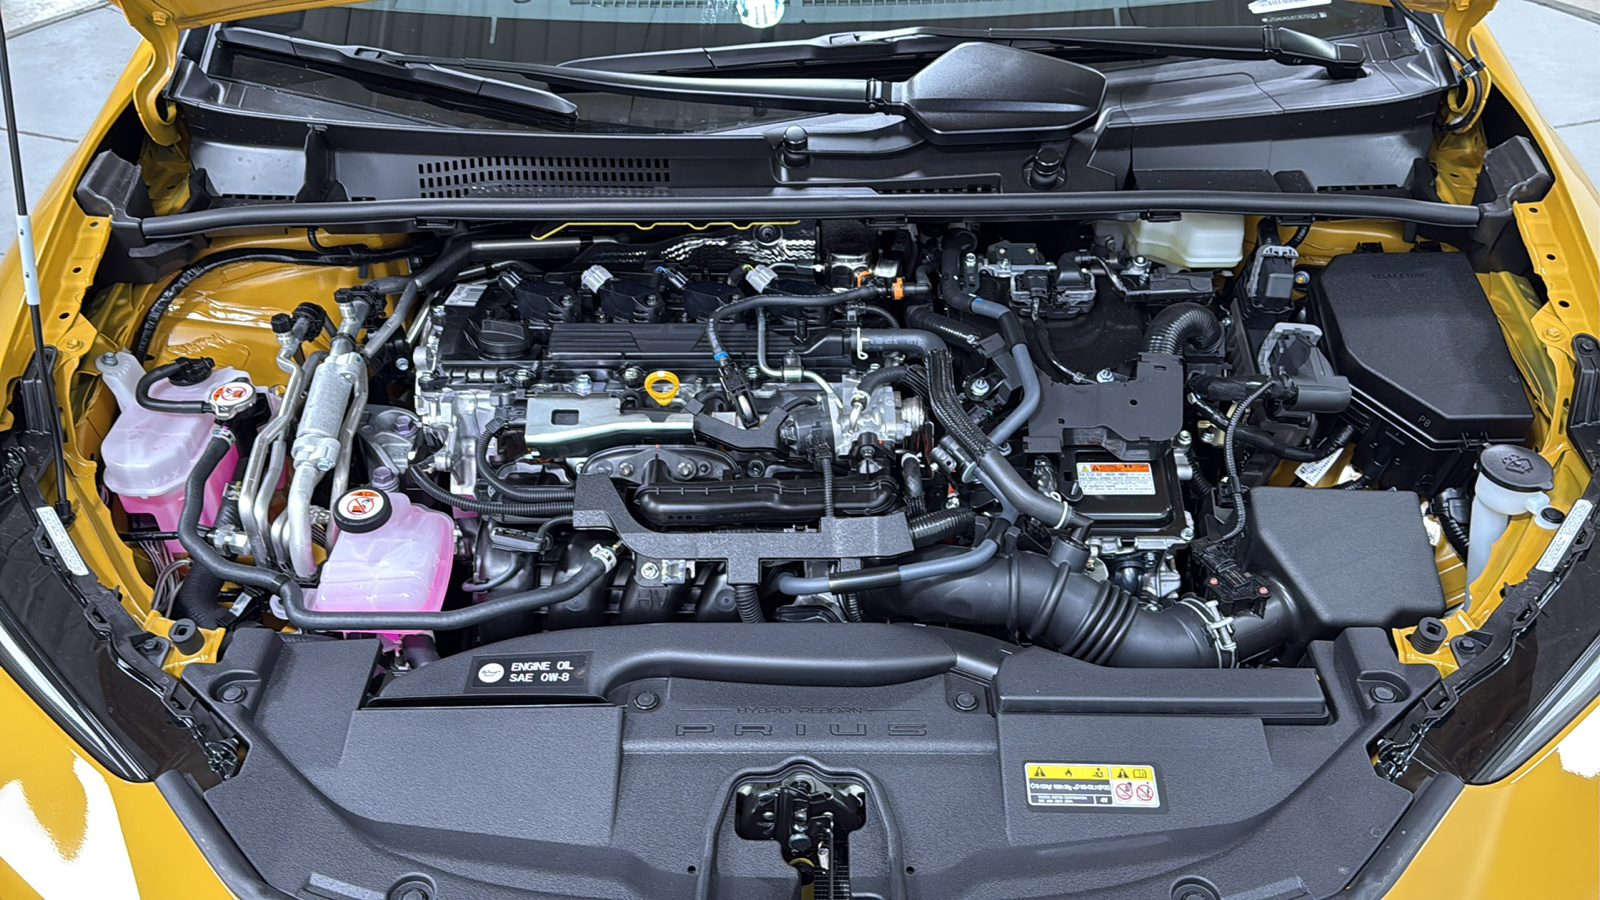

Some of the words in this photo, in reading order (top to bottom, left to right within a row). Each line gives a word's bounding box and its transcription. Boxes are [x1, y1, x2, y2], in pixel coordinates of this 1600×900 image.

[510, 661, 552, 672] ENGINE
[556, 660, 574, 671] OIL
[508, 673, 534, 683] SAE
[540, 672, 570, 682] 0W-8
[736, 706, 792, 715] HYBRID
[798, 706, 863, 715] REBORN
[674, 722, 928, 737] PRIUS
